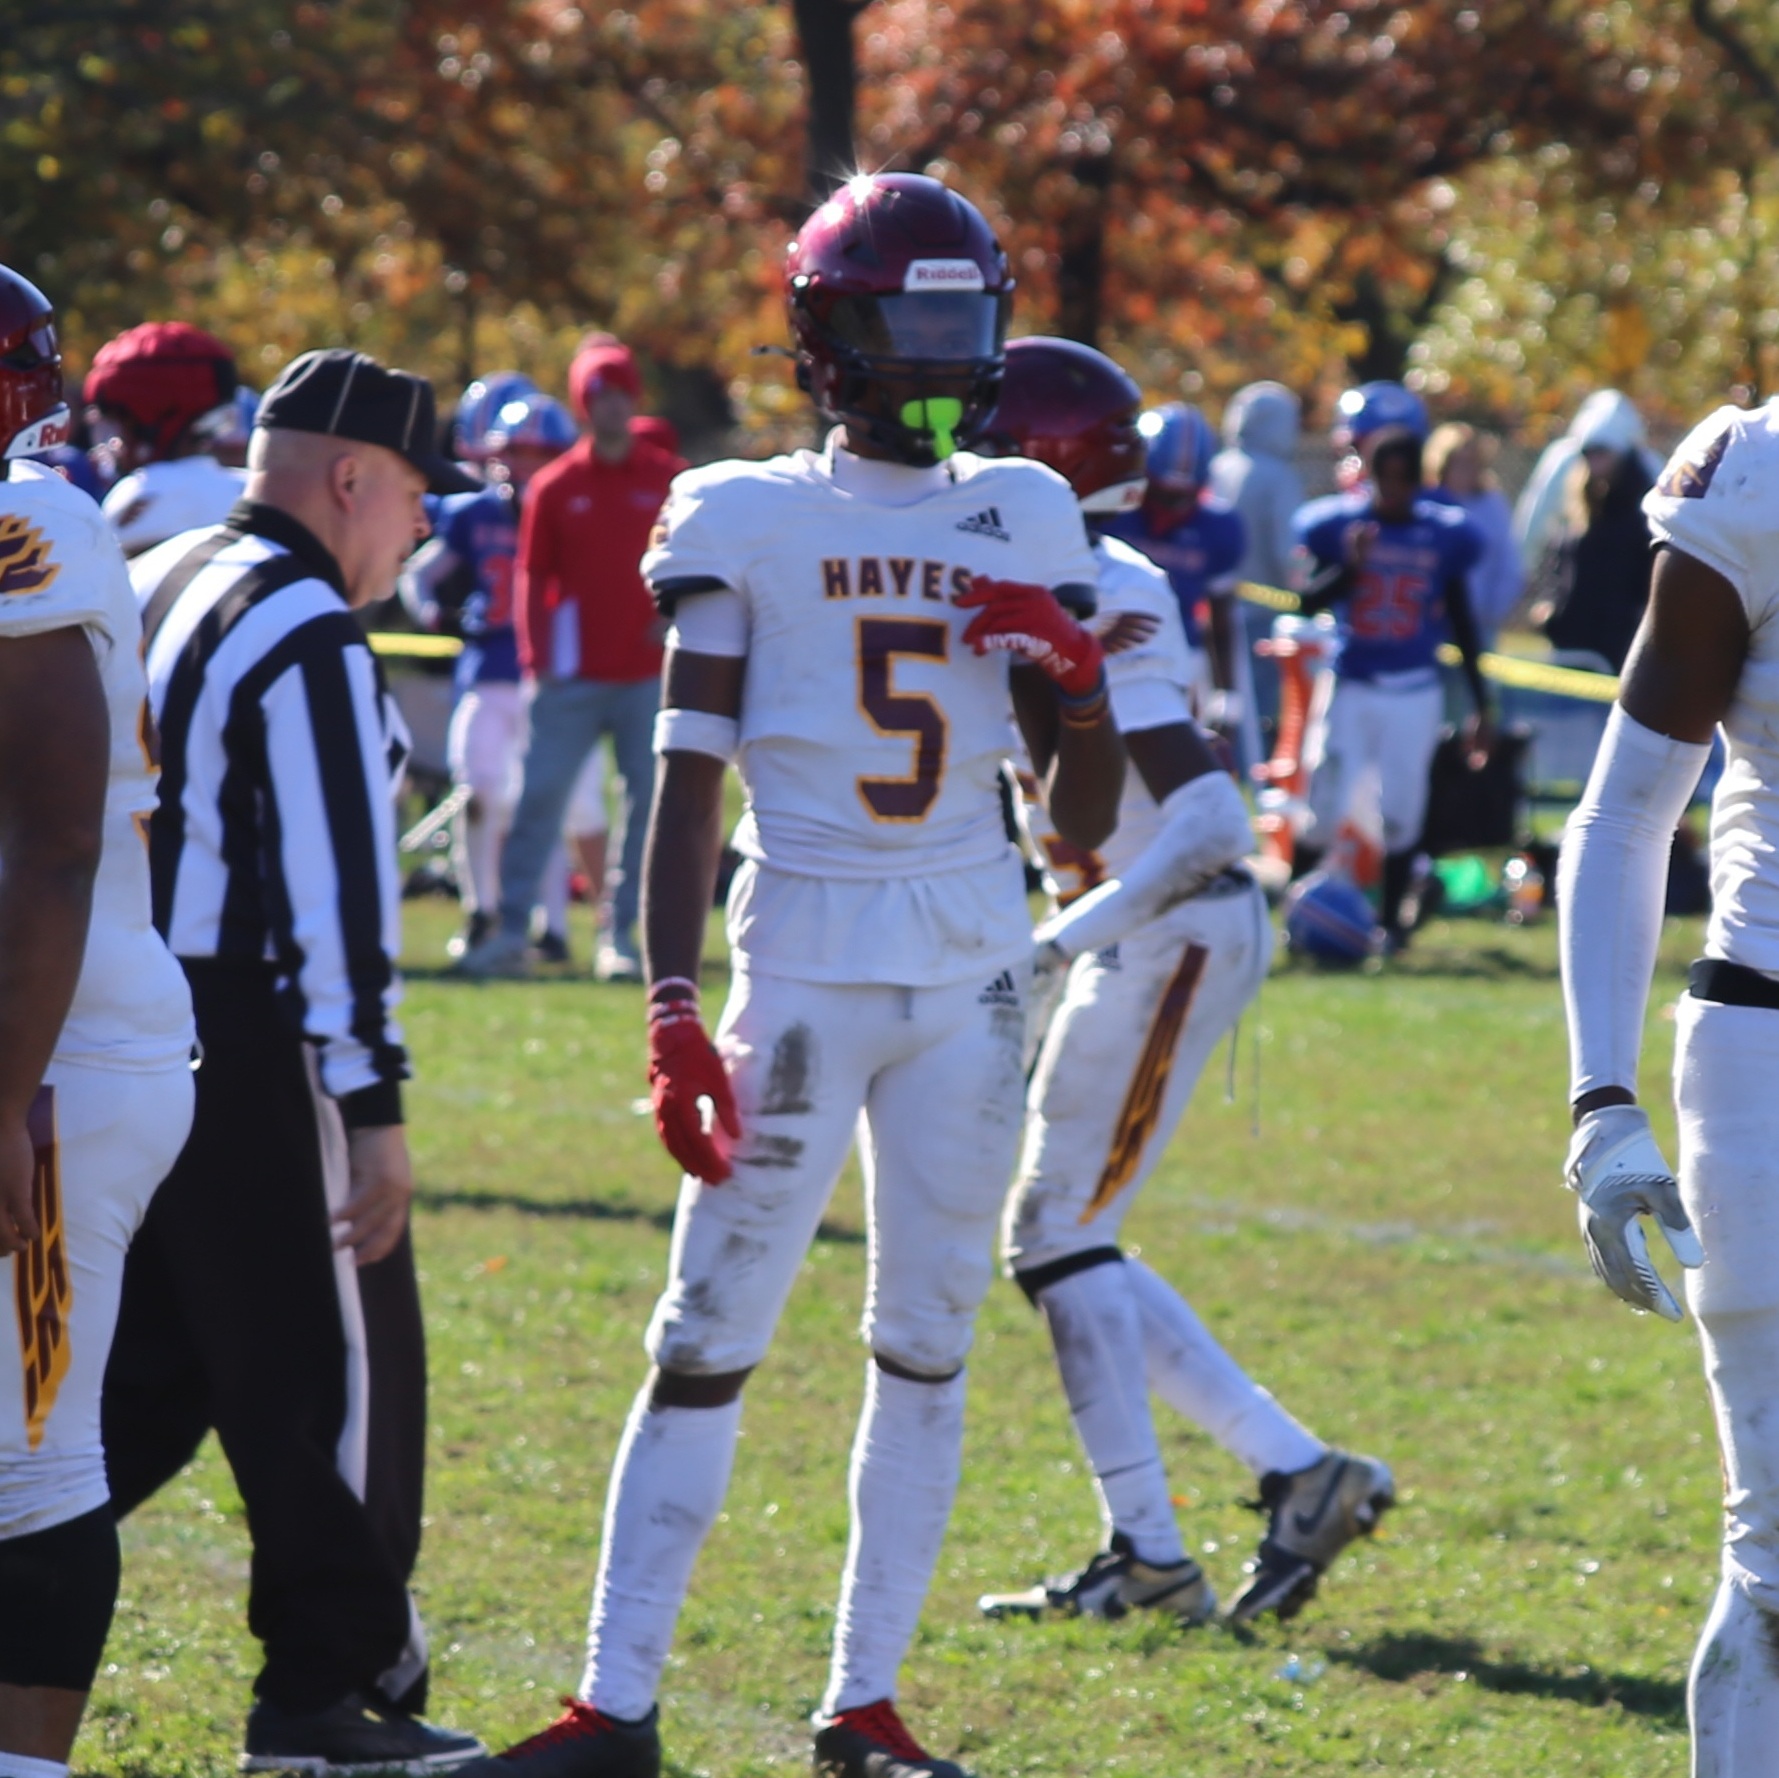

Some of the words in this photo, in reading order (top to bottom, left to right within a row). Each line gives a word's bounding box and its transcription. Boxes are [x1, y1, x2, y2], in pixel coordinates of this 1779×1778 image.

[916, 266, 980, 280] Riddell
[822, 557, 972, 603] HAYES
[854, 614, 950, 824] 5
